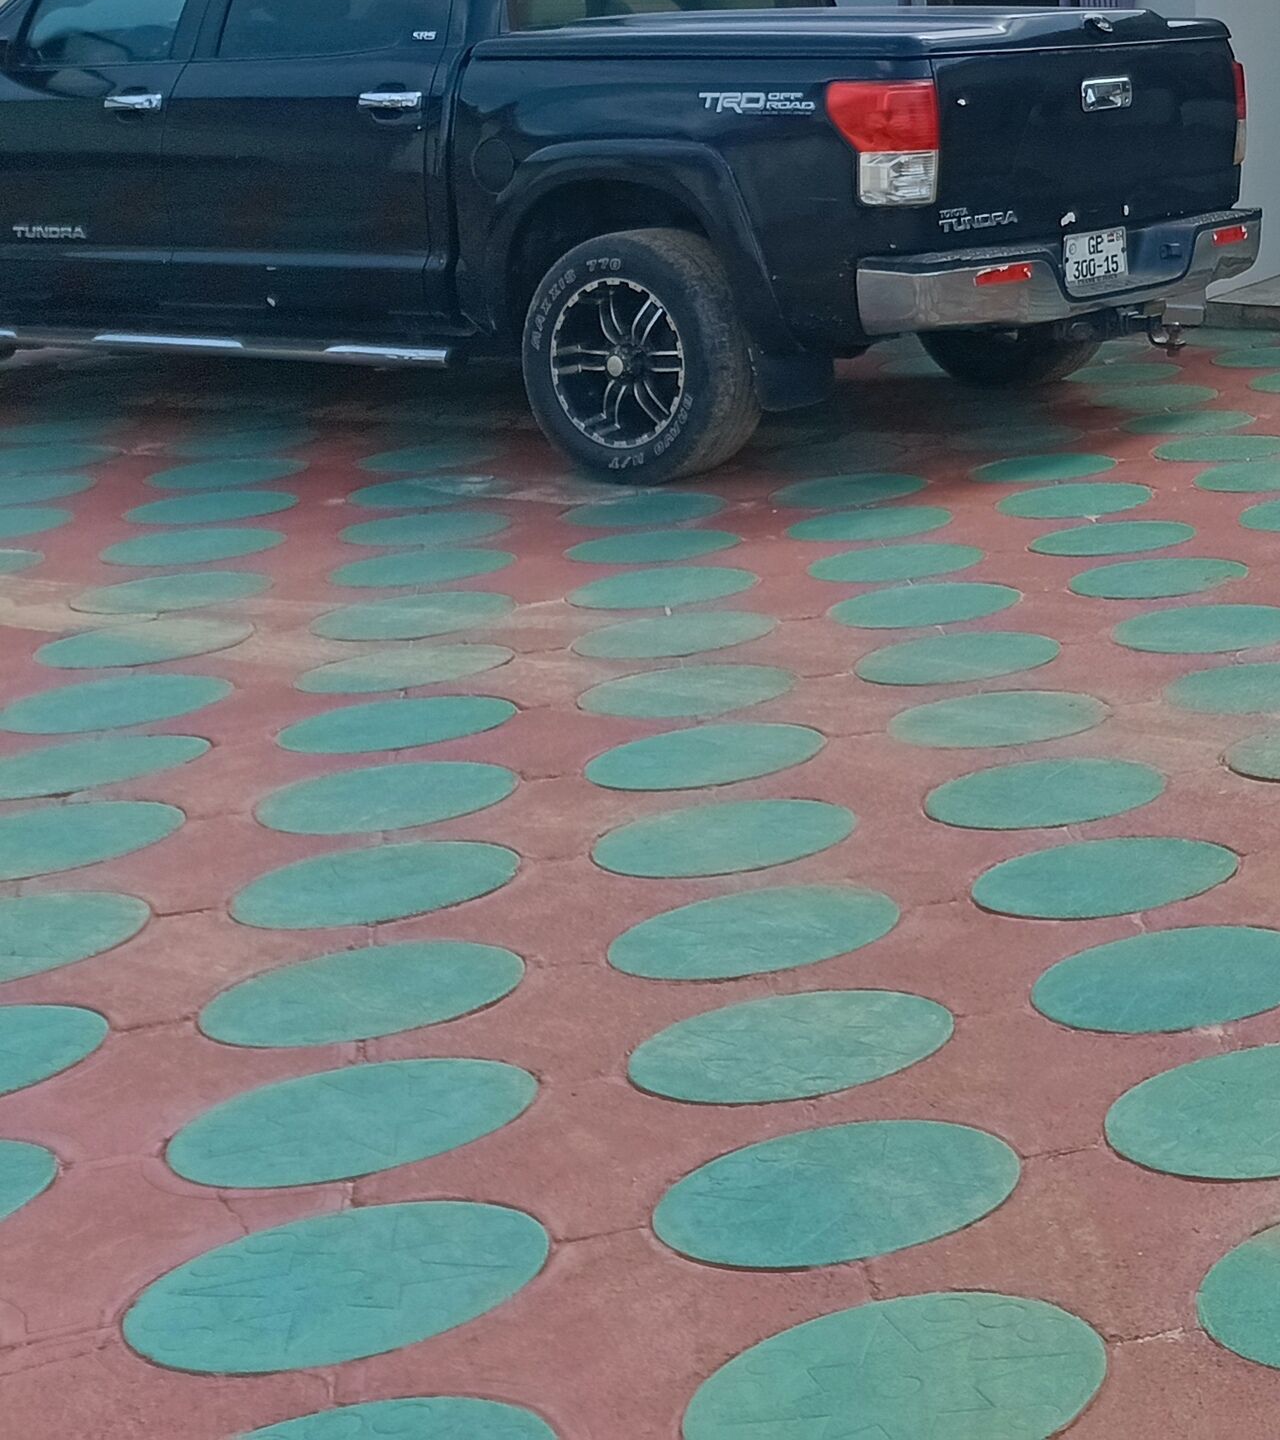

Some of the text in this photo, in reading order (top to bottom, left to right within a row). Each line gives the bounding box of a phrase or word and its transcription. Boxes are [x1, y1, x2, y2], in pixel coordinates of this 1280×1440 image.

[699, 92, 766, 114] TRD
[766, 101, 815, 110] ROAD
[768, 92, 804, 101] OFF
[12, 226, 86, 239] TUNDRA
[939, 210, 1018, 233] TUNDRA
[1073, 254, 1119, 279] 300-15
[531, 268, 577, 350] MAXXIS
